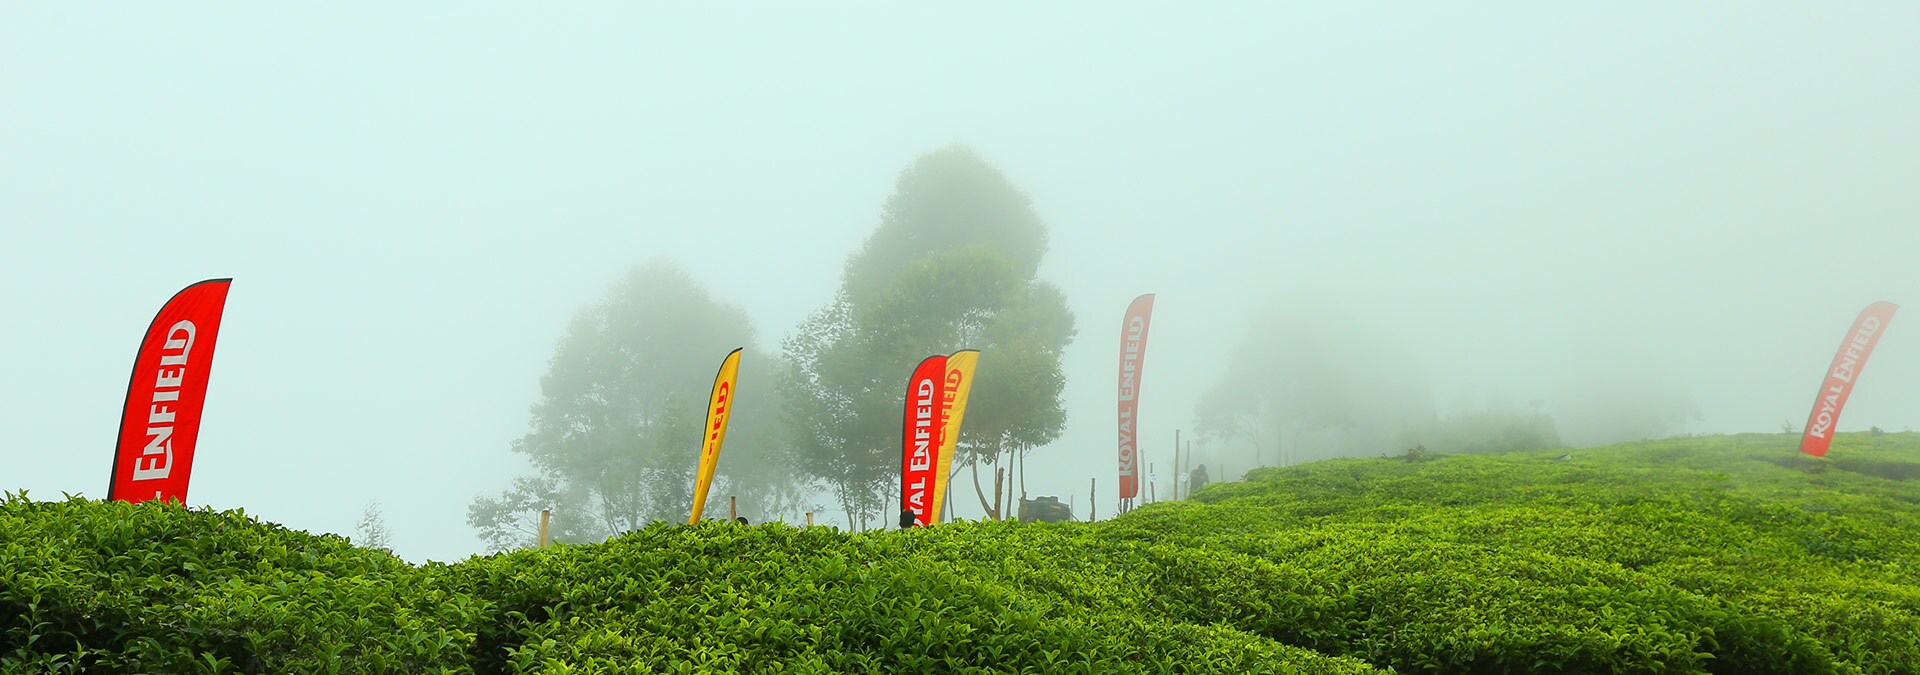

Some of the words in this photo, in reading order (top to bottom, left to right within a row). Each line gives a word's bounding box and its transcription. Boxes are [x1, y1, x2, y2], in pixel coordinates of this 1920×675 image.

[132, 319, 197, 481] ENFIELD
[1119, 315, 1145, 401] ENFIELD
[1810, 385, 1844, 439] ROYAL
[1832, 315, 1881, 383] ENFIELD
[909, 378, 935, 472] ENFIELD
[1118, 406, 1135, 477] ROYAL
[909, 476, 926, 528] YAL
